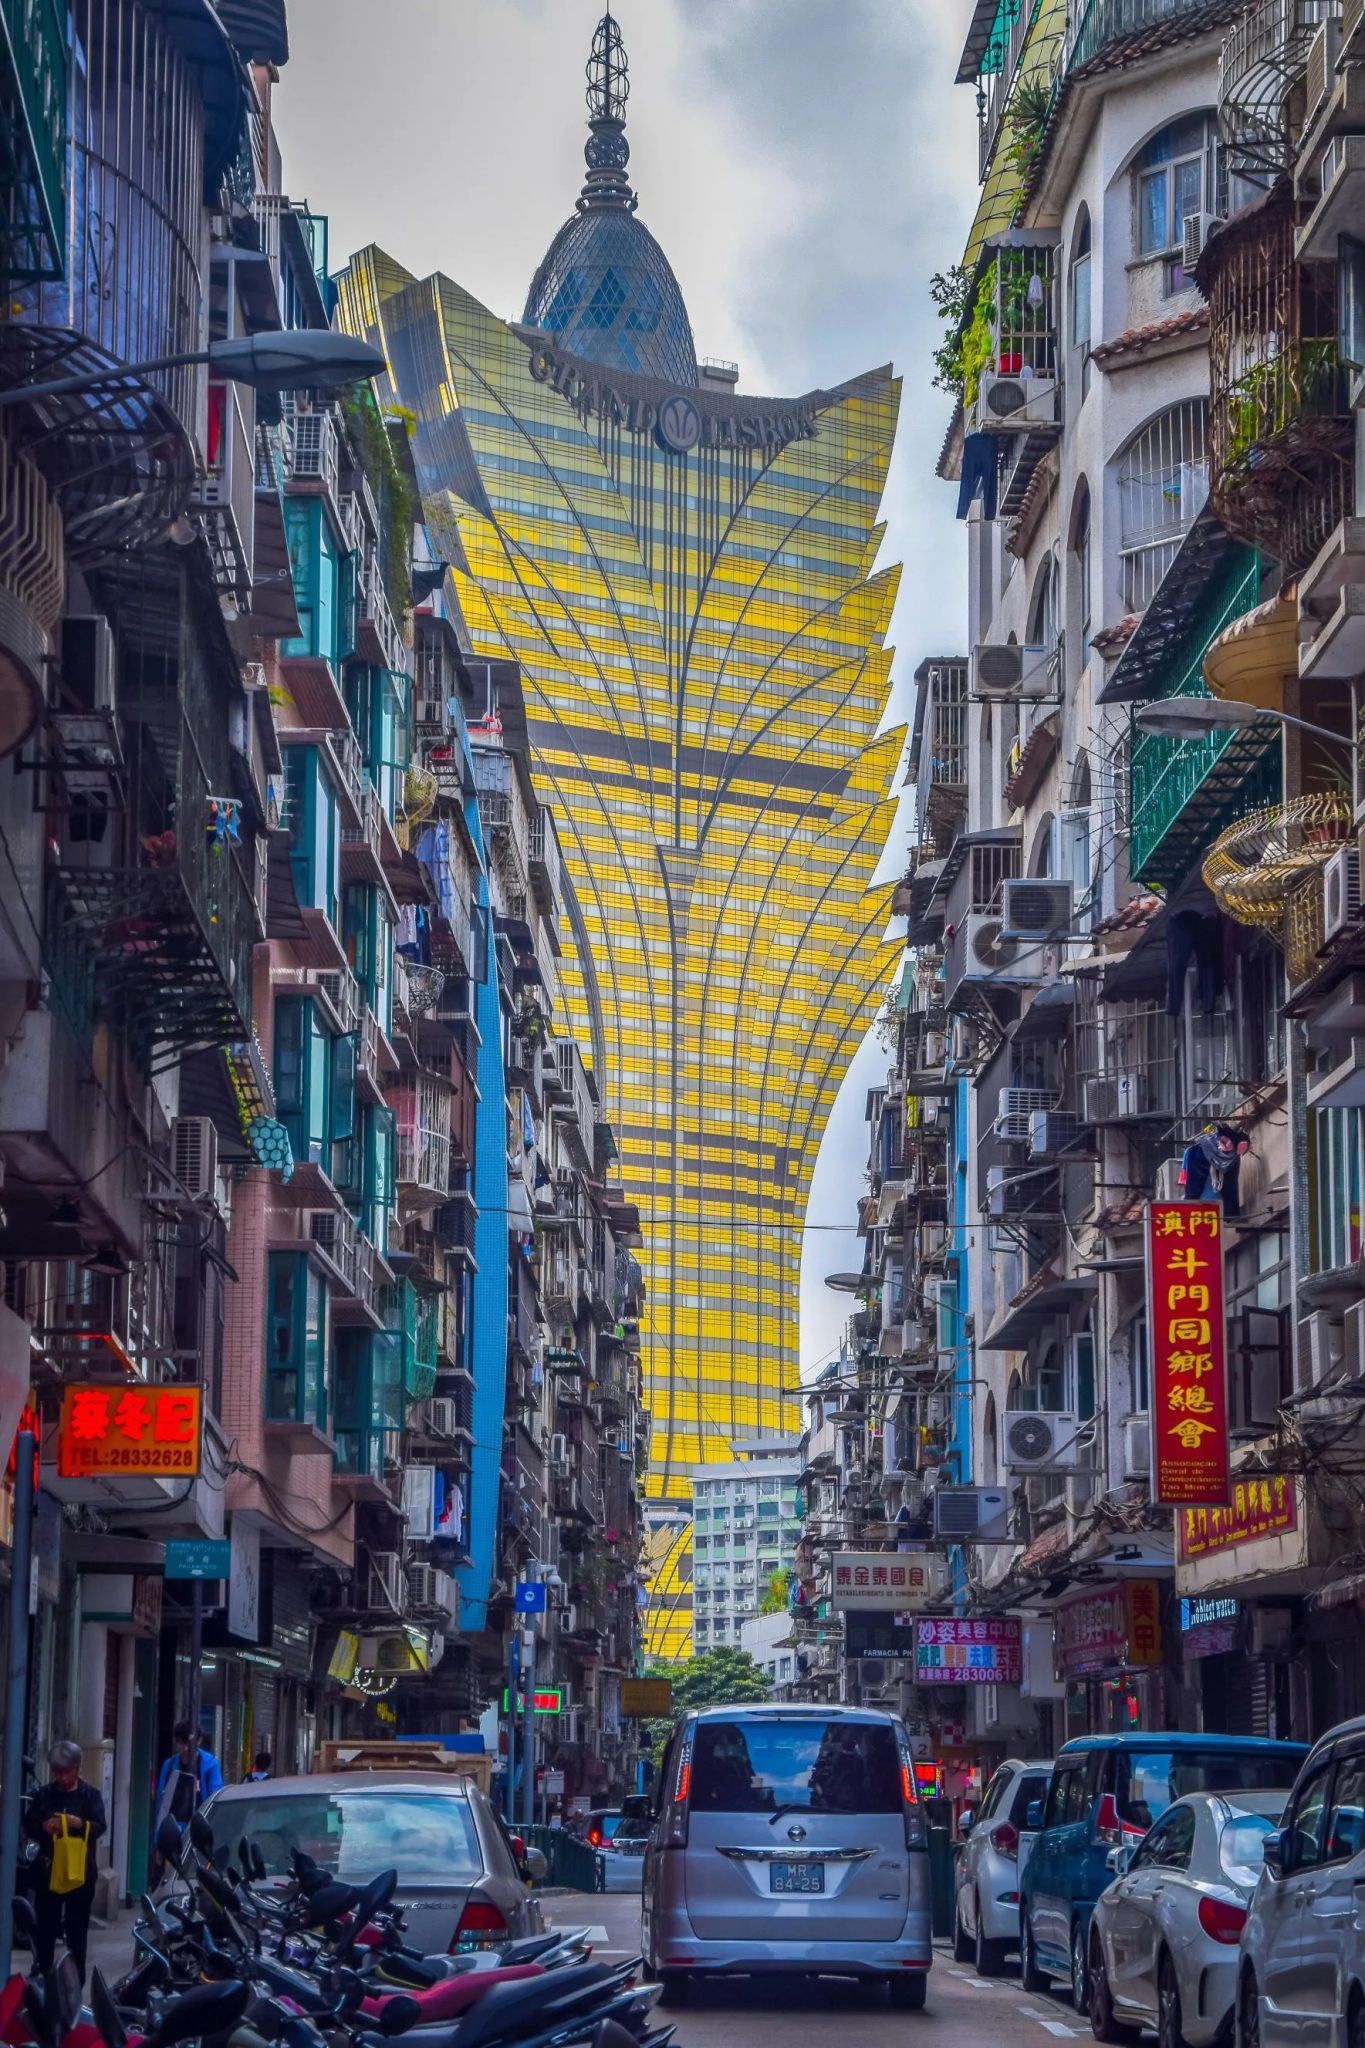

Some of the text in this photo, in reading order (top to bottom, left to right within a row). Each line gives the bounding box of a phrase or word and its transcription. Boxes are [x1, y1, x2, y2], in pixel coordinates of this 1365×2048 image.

[529, 351, 821, 446] GRAND LISBOA
[1156, 1211, 1218, 1237] 澳門
[1166, 1248, 1217, 1448] 斗門同鄉總會
[72, 1391, 195, 1442] 蔡冬記
[70, 1448, 193, 1467] TEL:28332628
[918, 1621, 1018, 1644] 妙姿美容中心
[1133, 1585, 1155, 1660] 美甲
[863, 1649, 899, 1657] FARMACIA
[787, 1864, 807, 1876] MR
[775, 1878, 820, 1890] 84-25
